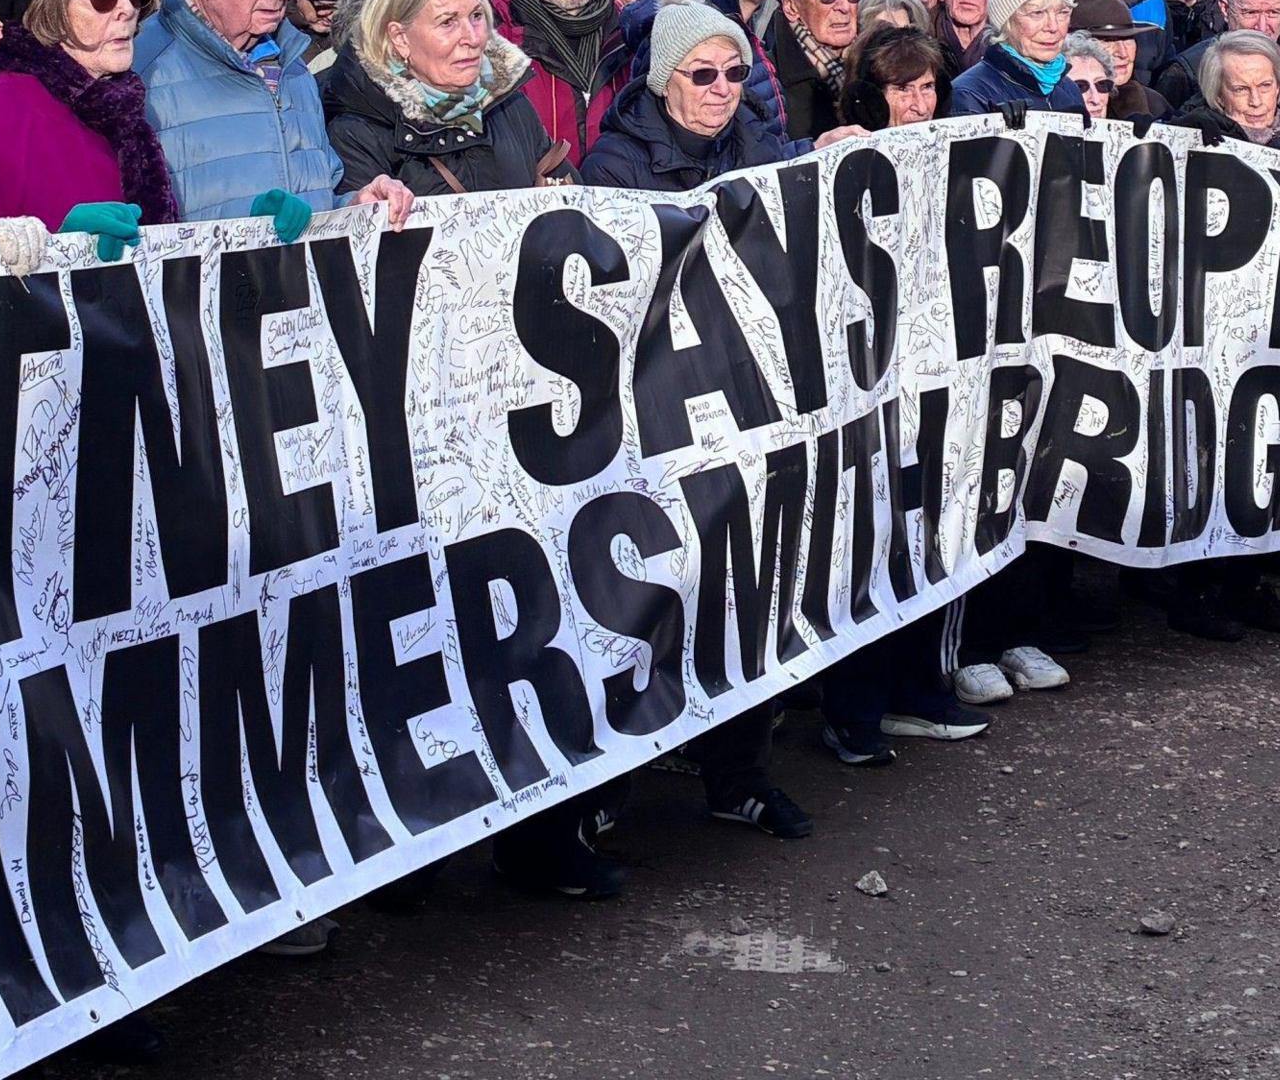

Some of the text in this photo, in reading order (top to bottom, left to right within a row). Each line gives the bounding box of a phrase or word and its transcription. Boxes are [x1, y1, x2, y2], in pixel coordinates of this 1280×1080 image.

[510, 148, 901, 488] SAYS
[449, 338, 507, 369] EVA
[420, 511, 452, 533] Betty
